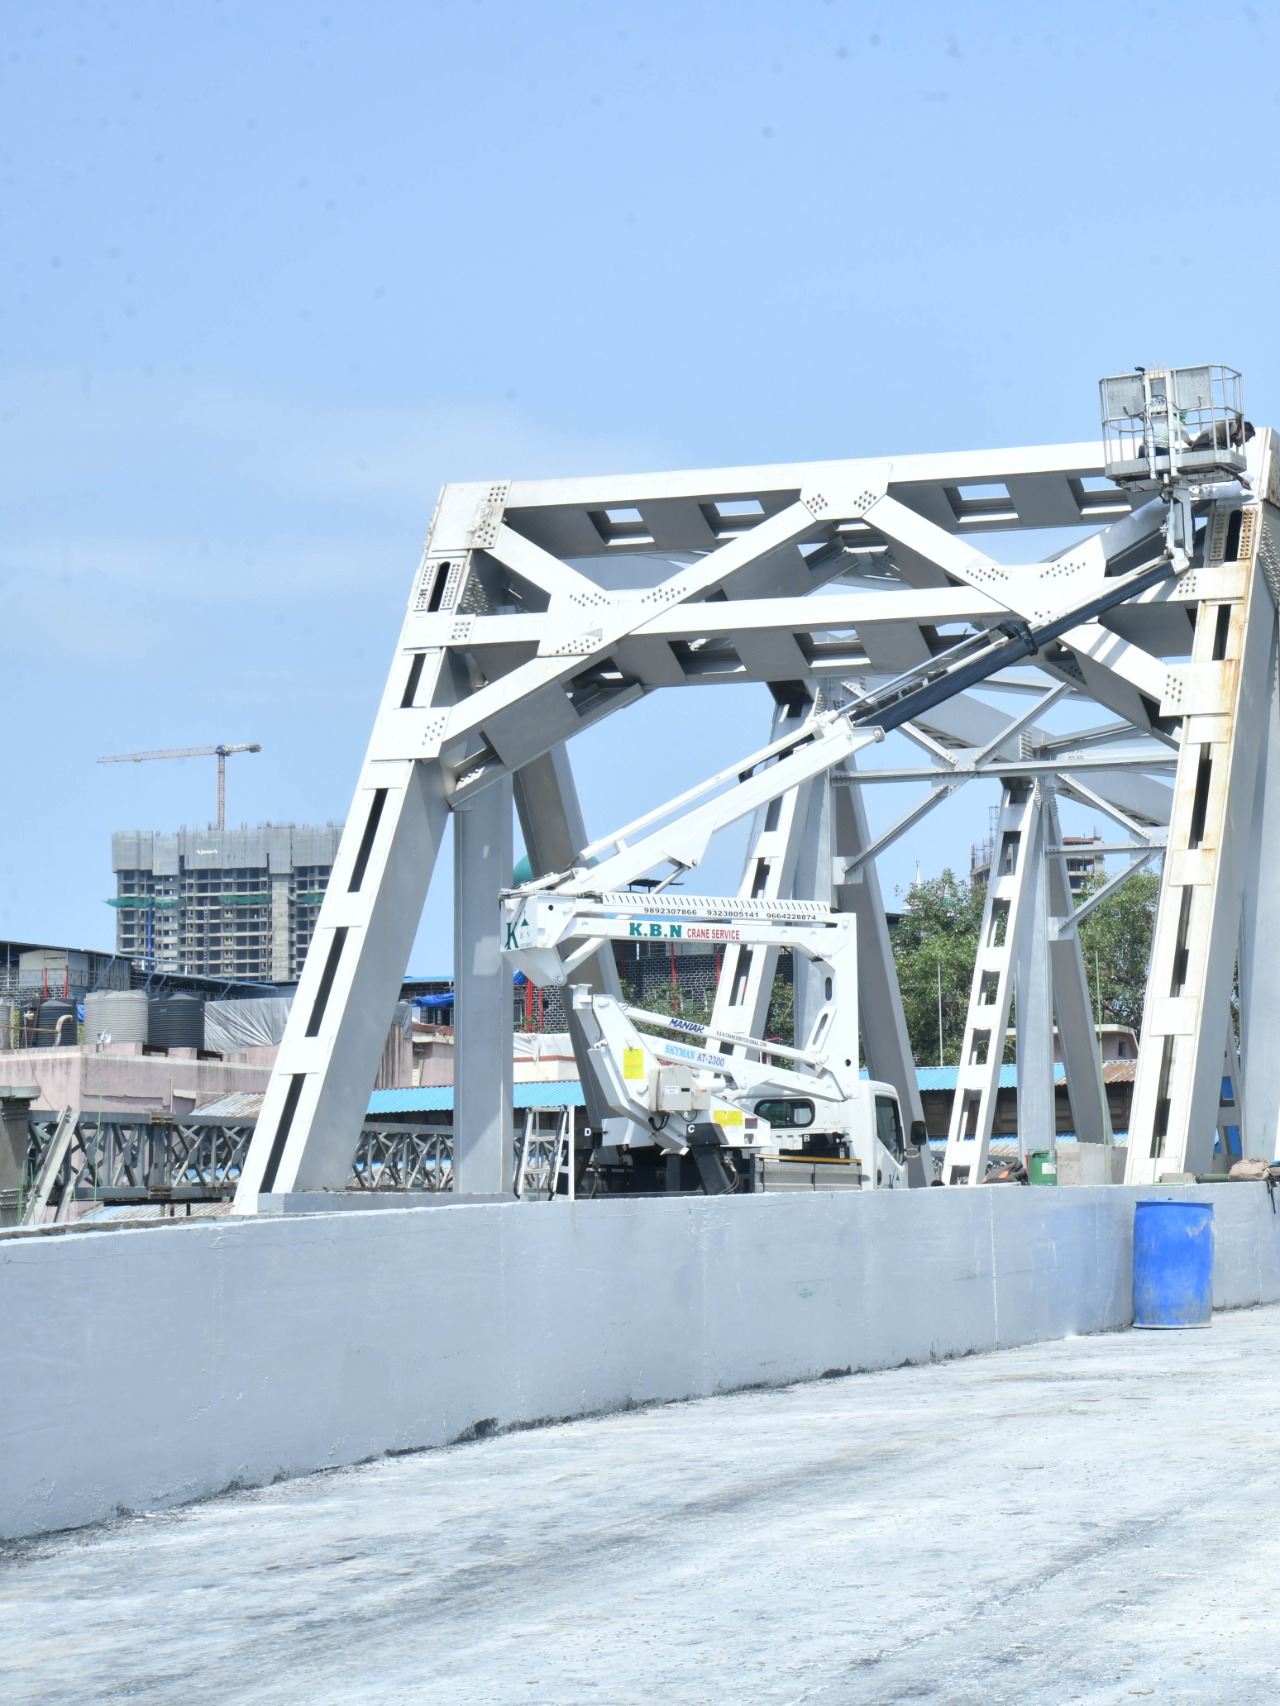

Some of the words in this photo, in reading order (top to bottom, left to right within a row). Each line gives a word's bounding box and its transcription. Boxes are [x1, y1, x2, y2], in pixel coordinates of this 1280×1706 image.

[643, 907, 697, 916] 9892307866
[706, 909, 759, 918] 9323805141
[766, 912, 817, 920] 9664228874
[629, 922, 682, 938] K.B.N
[687, 928, 710, 939] CRANE
[711, 929, 740, 940] SERVICE
[669, 1018, 704, 1033] MANIAK
[665, 1044, 695, 1060] SKYMAN
[697, 1053, 725, 1067] AT-2300
[584, 1127, 592, 1137] D
[688, 1123, 696, 1134] C
